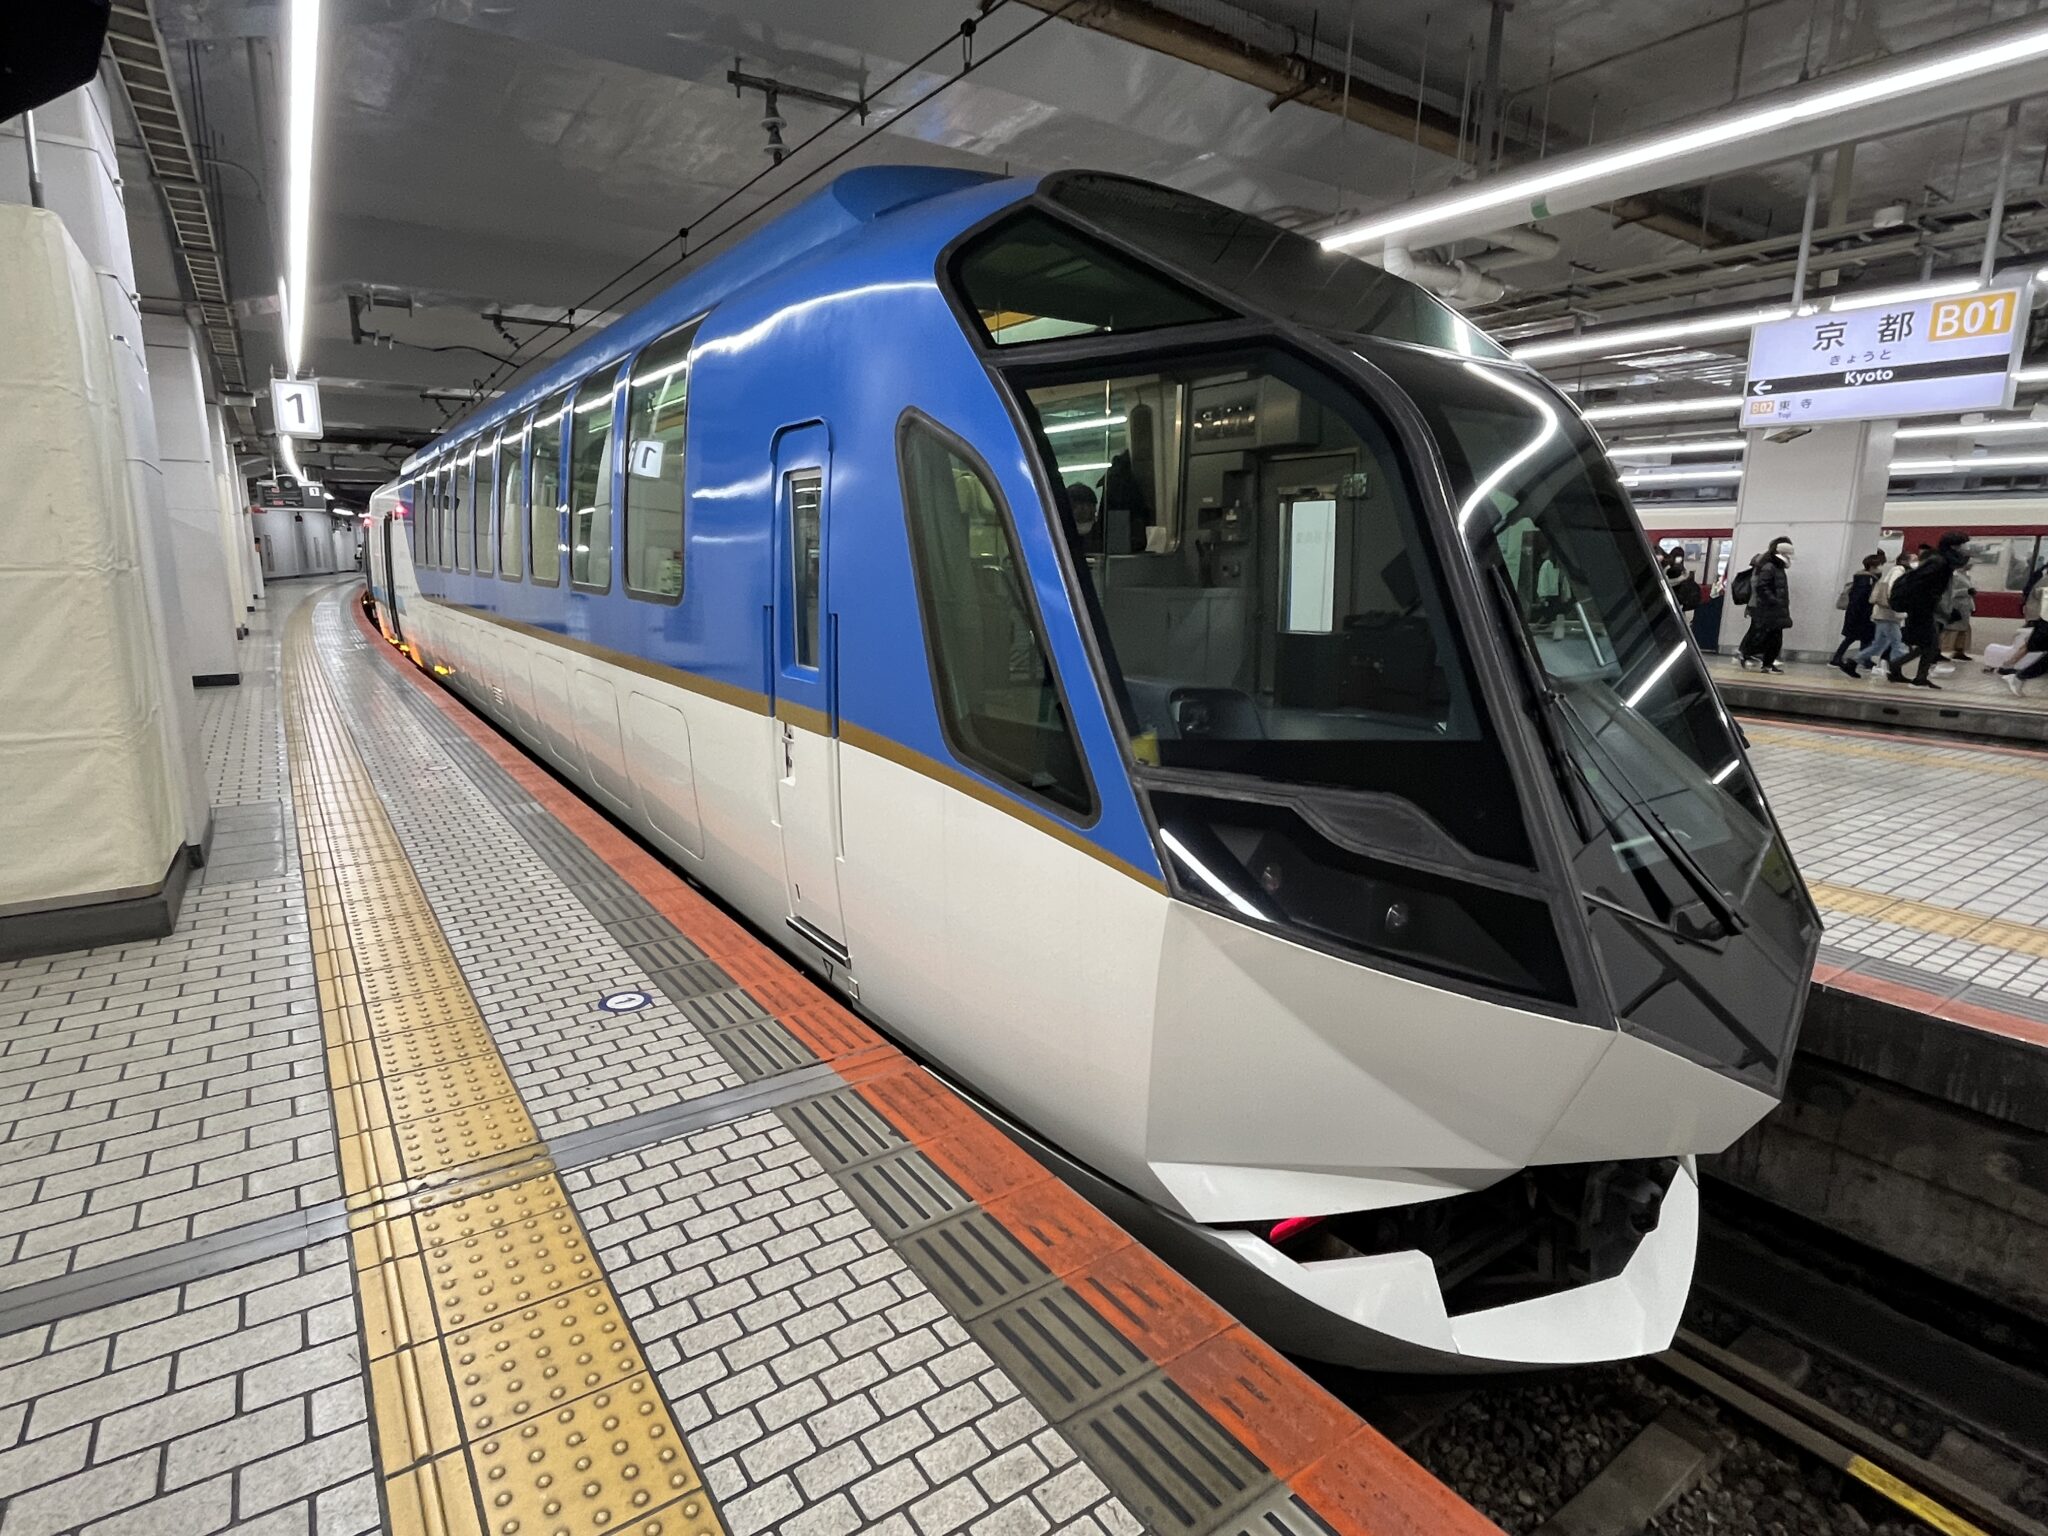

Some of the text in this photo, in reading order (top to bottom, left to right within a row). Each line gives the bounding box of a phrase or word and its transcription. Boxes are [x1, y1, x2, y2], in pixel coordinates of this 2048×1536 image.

[1813, 311, 1914, 350] 京都
[1936, 298, 2005, 337] B01
[1829, 350, 1892, 366] きょうと
[1844, 368, 1894, 385] Kyoto
[285, 393, 305, 424] 1
